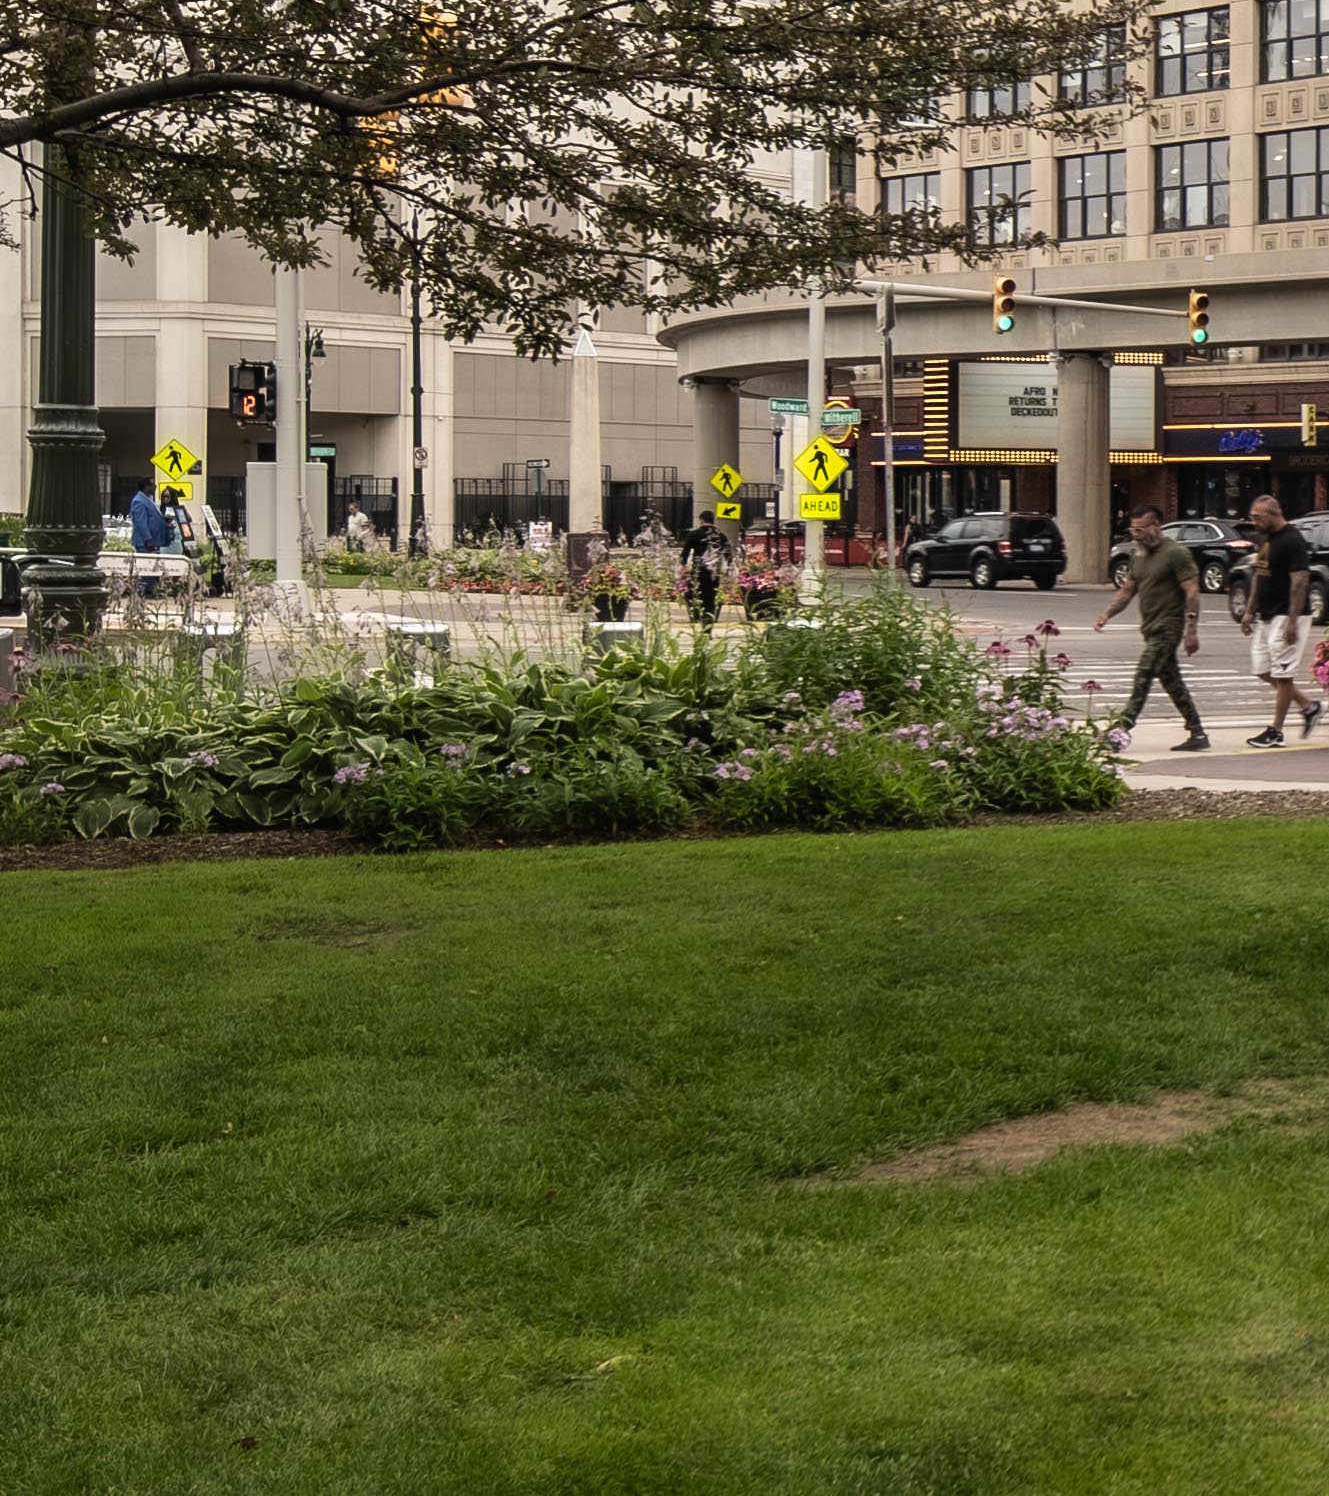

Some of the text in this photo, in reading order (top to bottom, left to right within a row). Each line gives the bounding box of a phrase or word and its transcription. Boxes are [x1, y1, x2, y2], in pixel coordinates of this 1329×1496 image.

[1023, 387, 1046, 396] AFRO
[243, 395, 256, 416] 12
[771, 401, 808, 412] Woodward
[1009, 397, 1047, 406] RETURNS
[824, 412, 859, 423] Witherell
[803, 501, 838, 512] AHEAD
